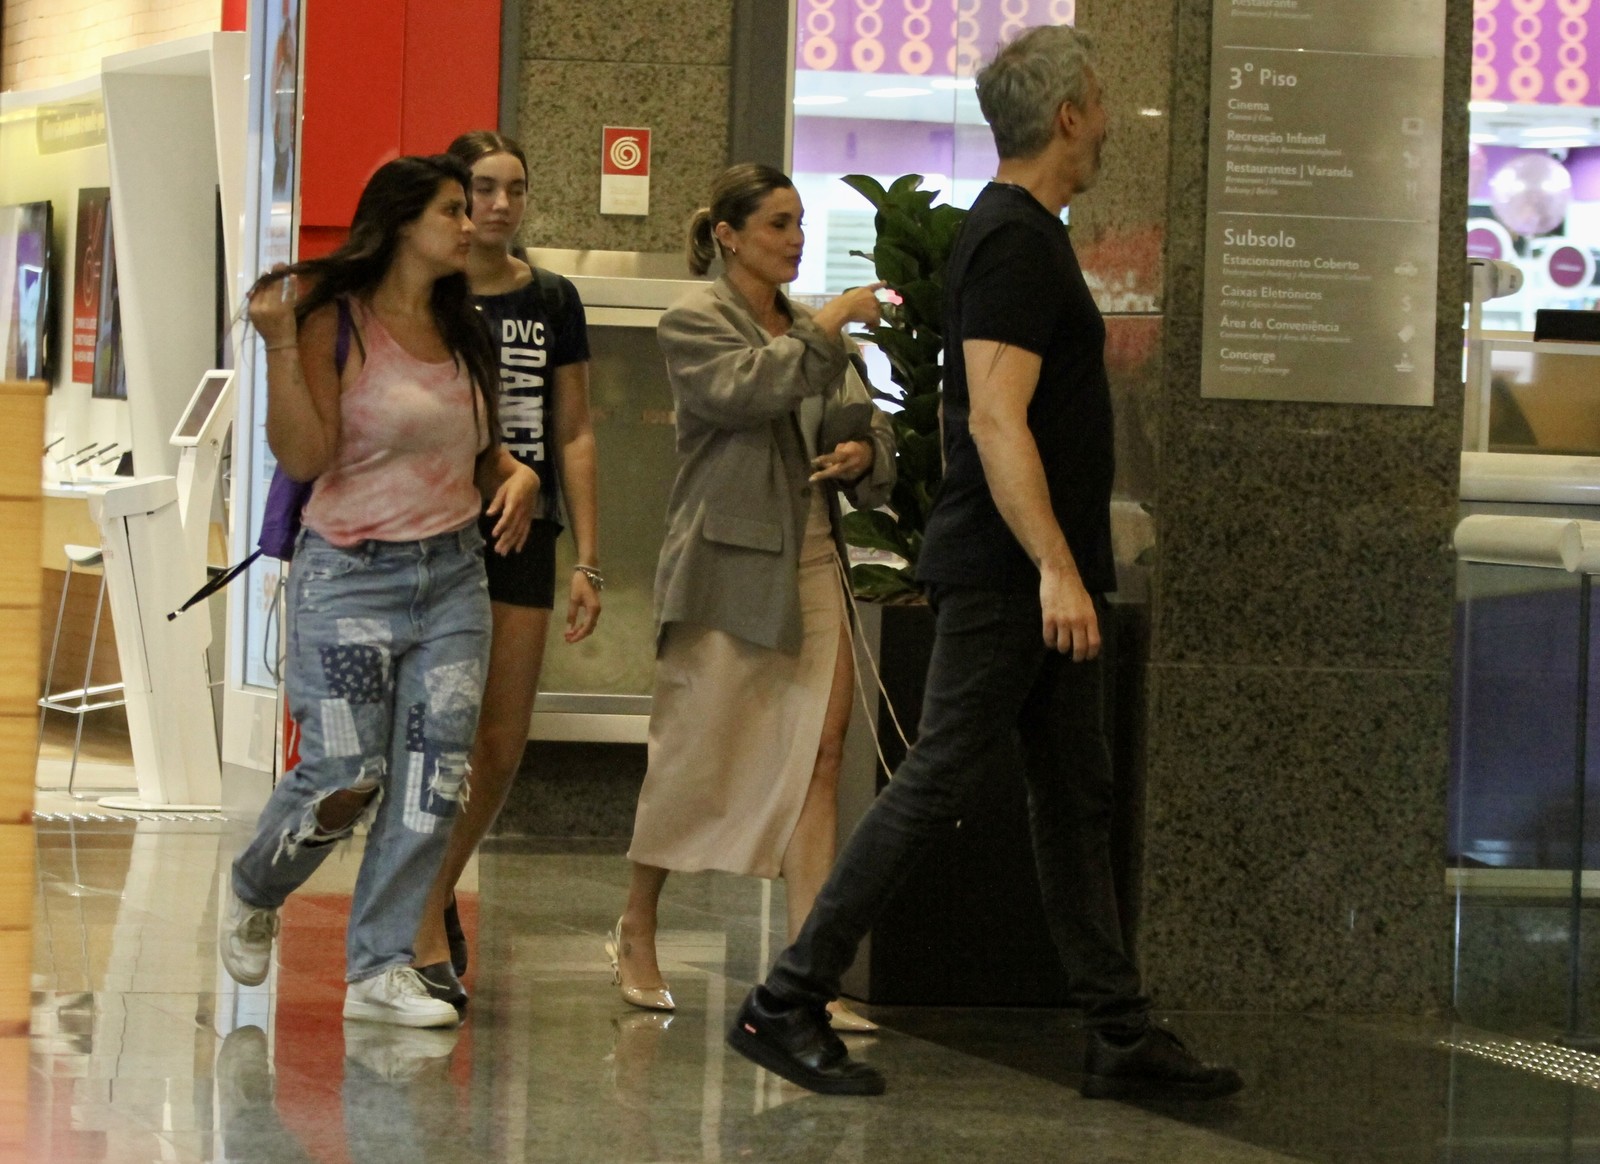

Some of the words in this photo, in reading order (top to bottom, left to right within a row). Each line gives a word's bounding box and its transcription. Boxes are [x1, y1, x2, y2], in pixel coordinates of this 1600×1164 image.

[1260, 68, 1297, 87] Piso
[1227, 98, 1270, 111] Cinema
[1226, 130, 1283, 145] Recreação
[1286, 132, 1326, 144] Infantil
[1226, 161, 1297, 175] Restaurantes
[1307, 165, 1354, 178] Varanda
[1223, 228, 1296, 248] Subsolo
[1223, 253, 1311, 269] Estacionamento
[1313, 257, 1360, 271] Coberto
[1221, 285, 1258, 298] Caixas
[1261, 286, 1323, 301] Eletrônicos
[502, 319, 545, 346] DVC
[1220, 314, 1246, 329] Área
[1249, 318, 1264, 330] de
[1266, 318, 1340, 333] Conveniência
[1220, 348, 1276, 364] Concierge
[499, 346, 547, 461] DANCE
